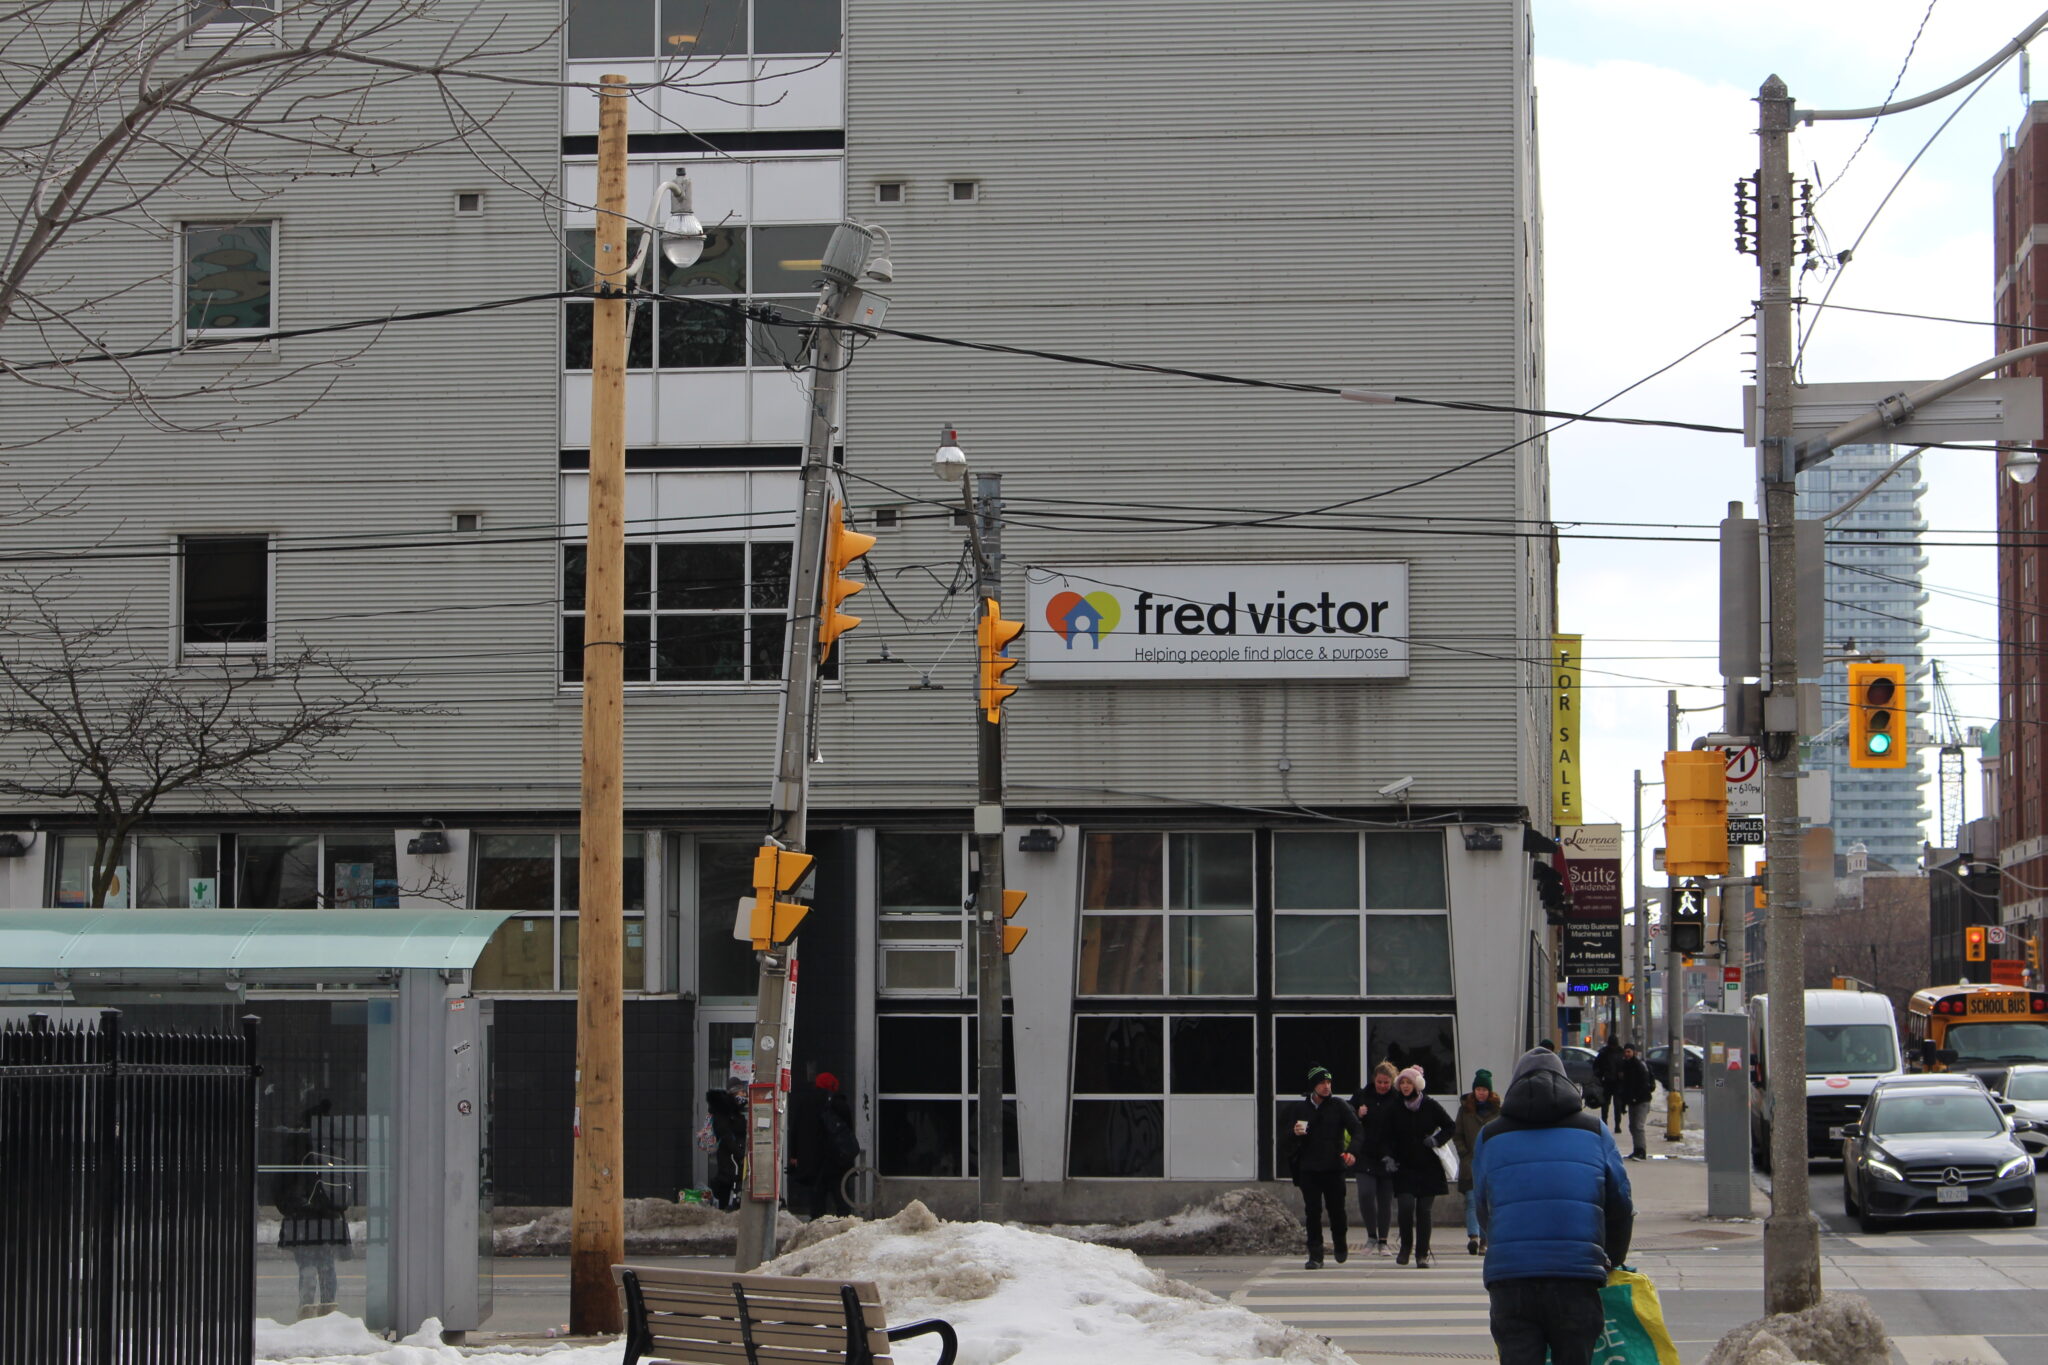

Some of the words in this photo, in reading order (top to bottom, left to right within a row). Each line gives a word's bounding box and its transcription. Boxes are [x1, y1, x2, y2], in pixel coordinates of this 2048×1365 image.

[1134, 591, 1236, 635] fred
[1247, 591, 1388, 634] victor
[1135, 647, 1187, 664] Helping
[1191, 647, 1240, 664] people
[1244, 646, 1269, 660] find
[1273, 646, 1314, 662] place
[1319, 647, 1328, 659] &
[1332, 648, 1389, 662] purpose
[1558, 653, 1572, 711] FOR
[1559, 728, 1571, 806] SALE
[1728, 821, 1762, 831] VEHICLES
[1564, 828, 1618, 851] Lawrence
[1569, 866, 1616, 883] Suite
[1590, 983, 1609, 992] NAP
[1971, 998, 2006, 1014] SCHOOL
[2008, 998, 2026, 1013] BUS
